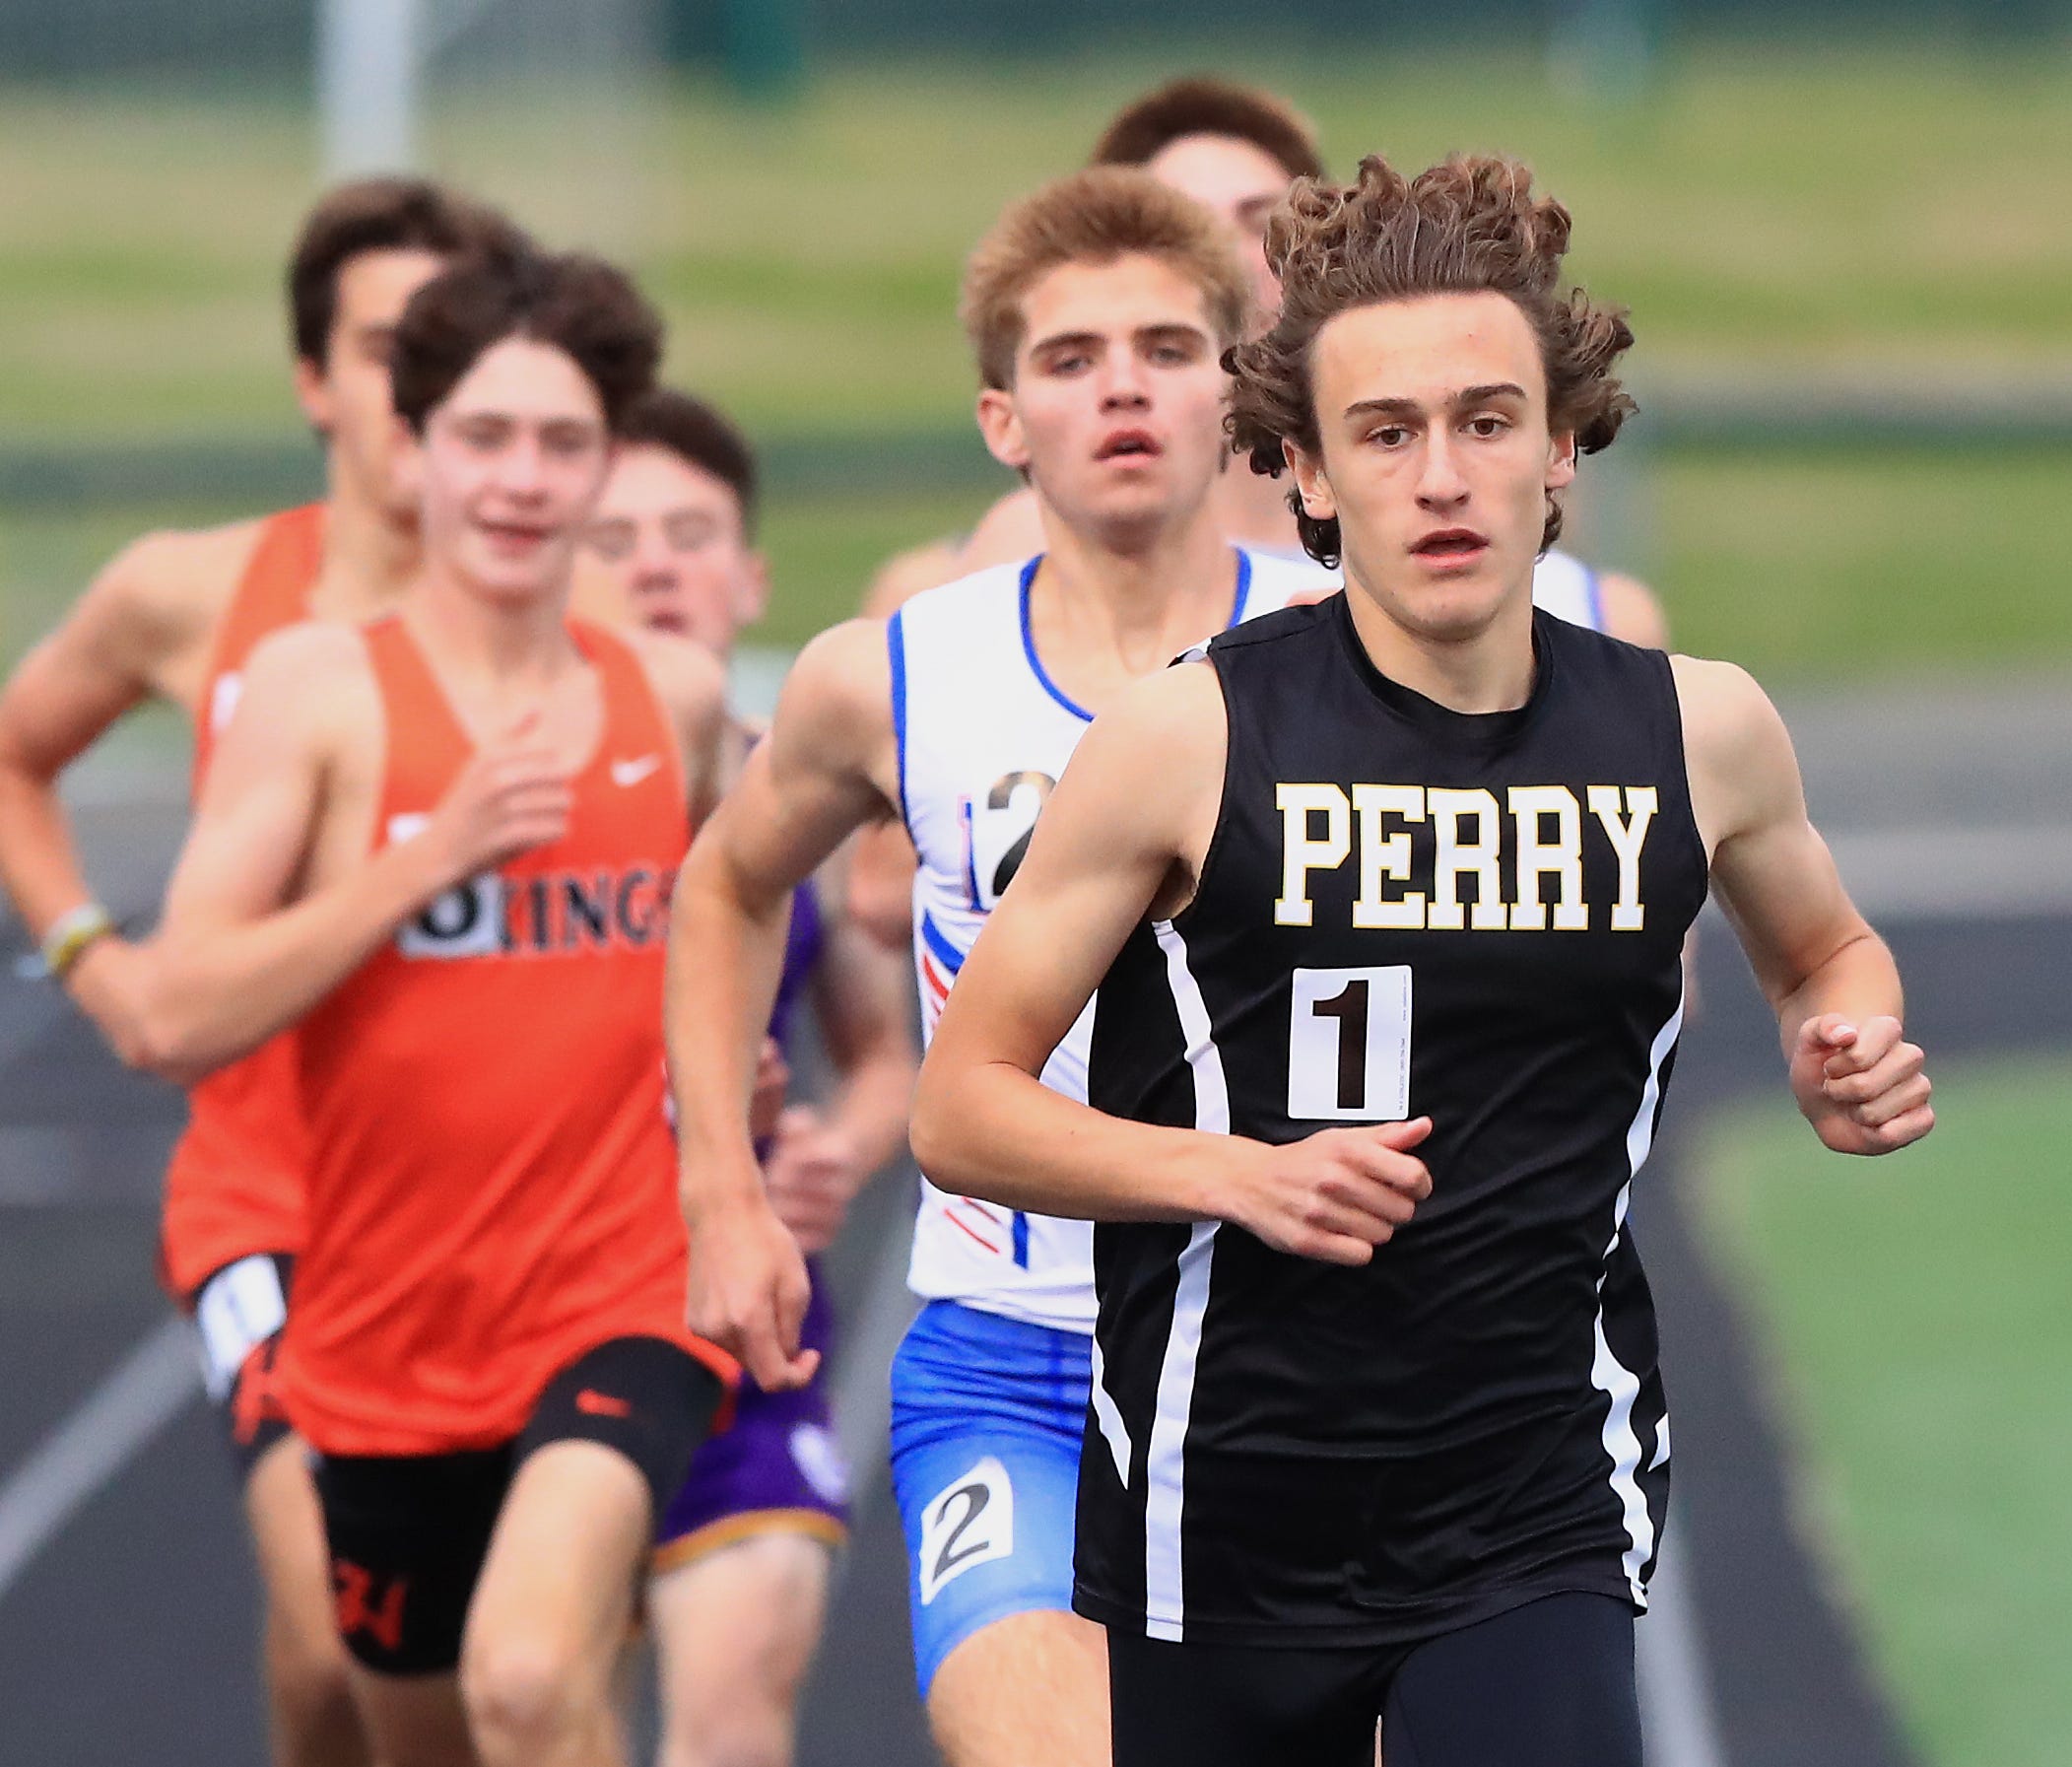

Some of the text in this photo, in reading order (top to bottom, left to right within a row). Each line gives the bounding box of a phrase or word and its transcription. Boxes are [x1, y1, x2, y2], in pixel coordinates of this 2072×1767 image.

[987, 771, 1056, 897] 2
[1274, 782, 1659, 931] PERRY
[1311, 979, 1370, 1110] 1
[933, 1482, 990, 1584] 2
